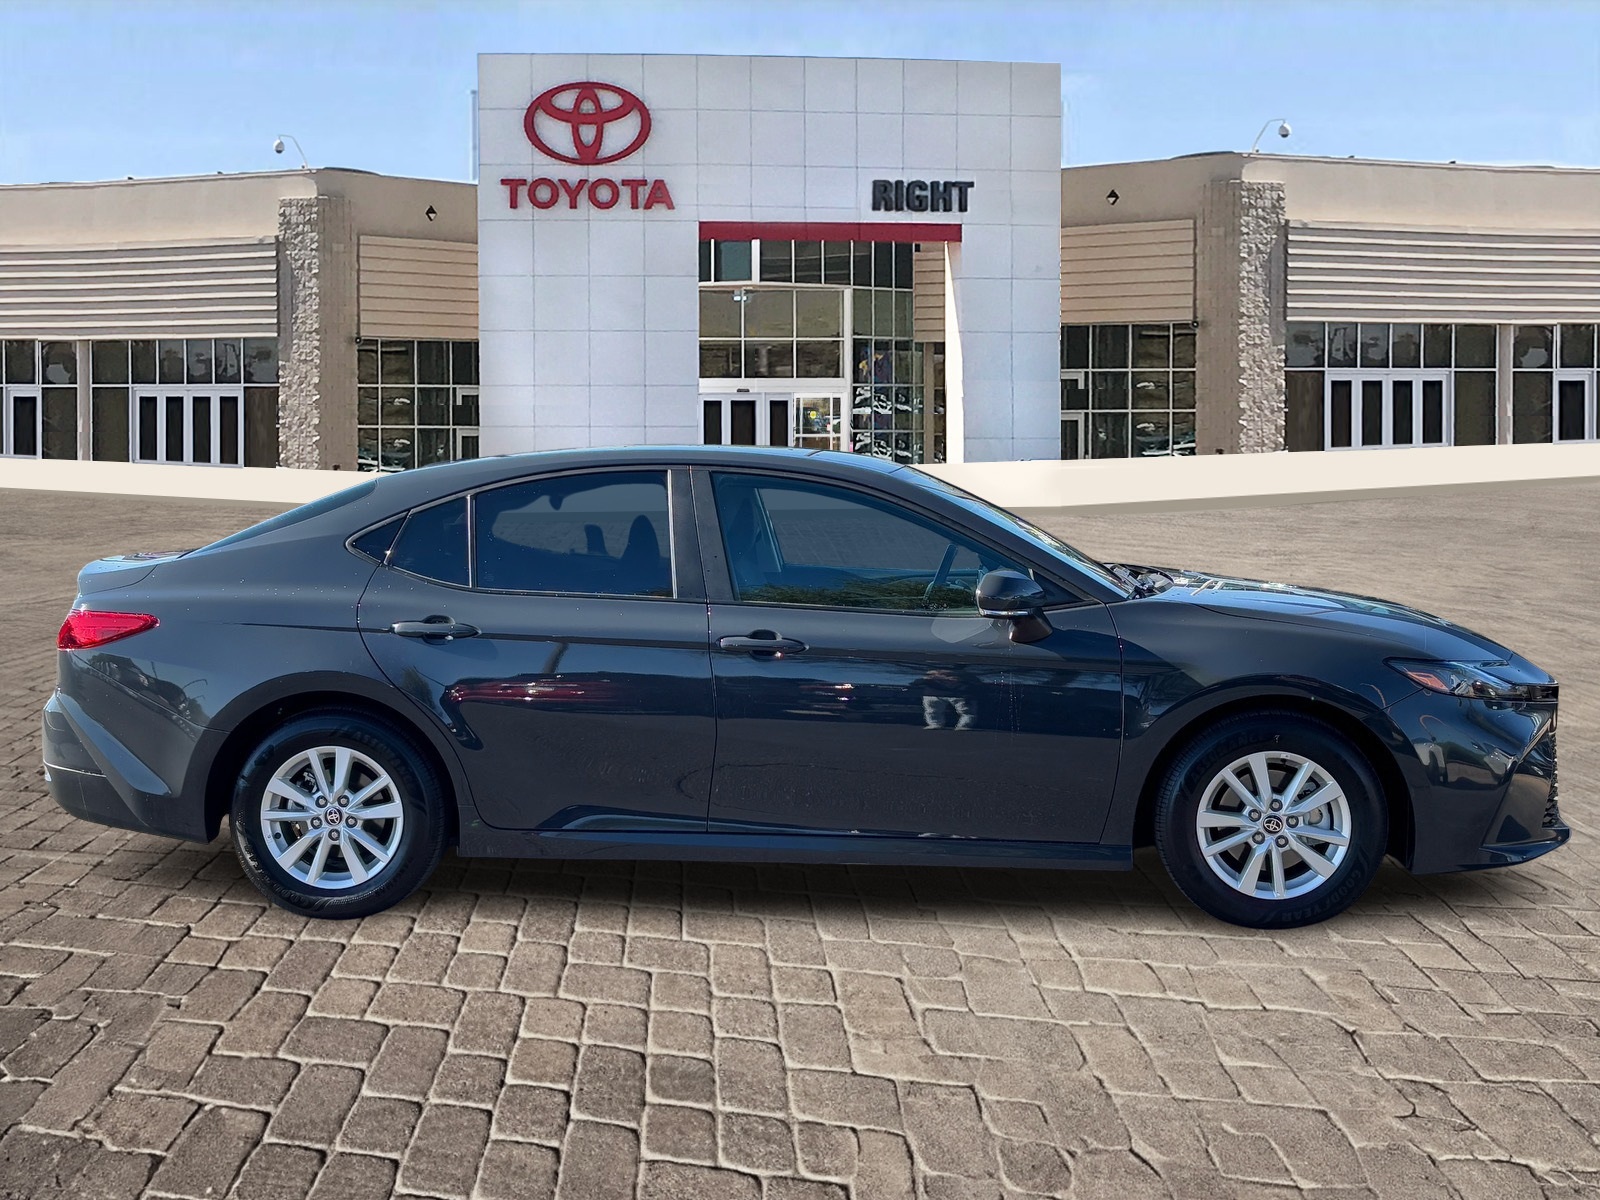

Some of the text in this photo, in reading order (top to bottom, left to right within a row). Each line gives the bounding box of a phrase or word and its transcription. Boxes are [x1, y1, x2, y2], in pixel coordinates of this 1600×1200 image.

[500, 178, 675, 209] TOYOTA
[872, 179, 975, 212] RIGHT
[1281, 870, 1362, 921] GOODYEAR
